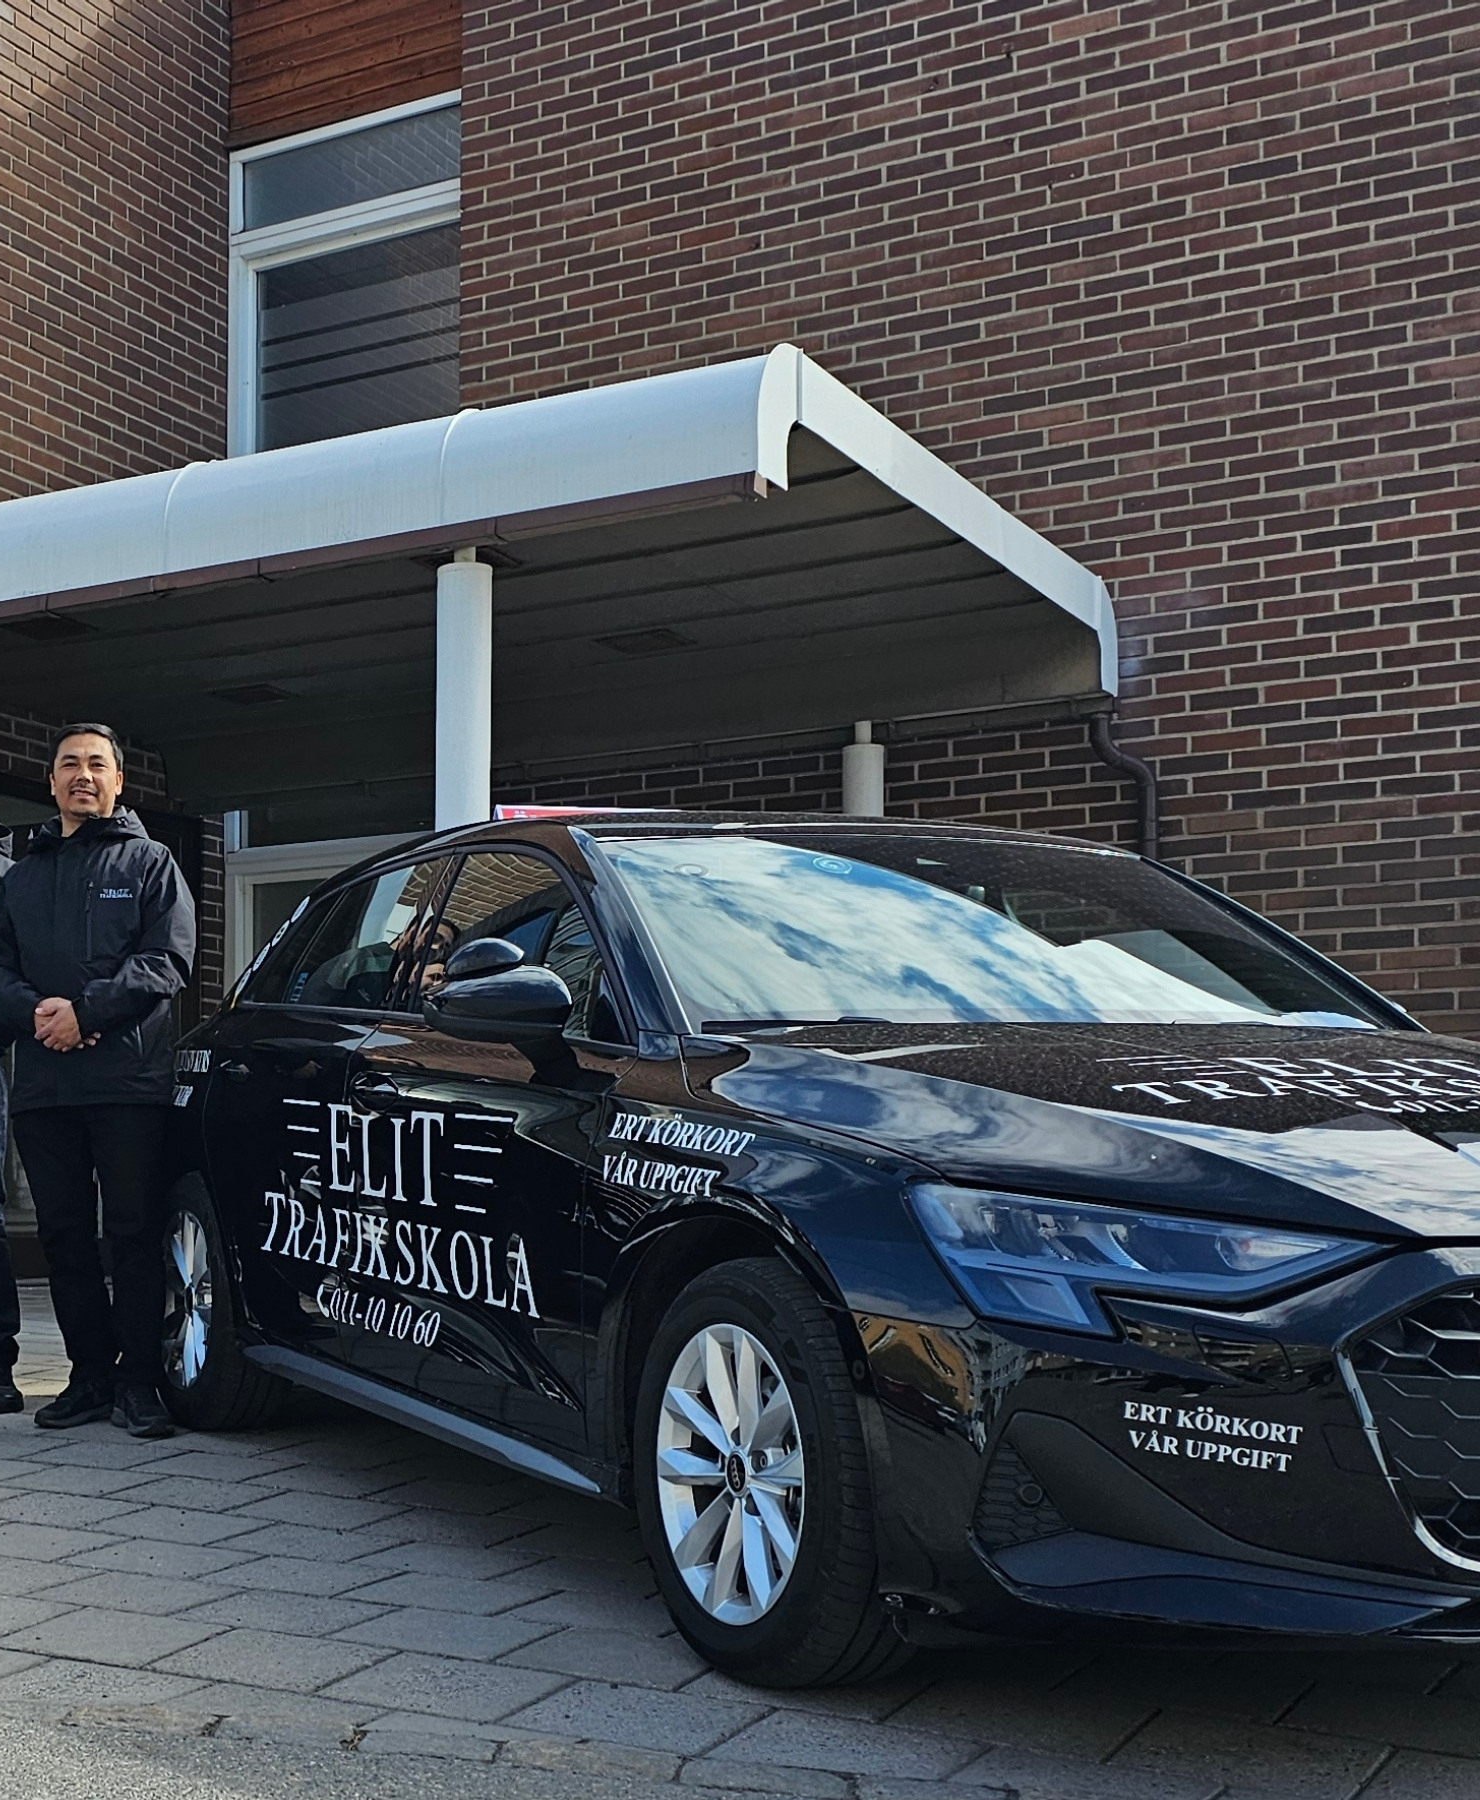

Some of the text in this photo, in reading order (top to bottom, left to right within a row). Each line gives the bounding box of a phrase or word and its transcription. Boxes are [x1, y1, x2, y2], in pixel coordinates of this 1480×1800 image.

[327, 1103, 444, 1207] ELIT
[608, 1112, 756, 1157] ERT KÖRKORT
[602, 1151, 721, 1197] VÅR UPPGIFT
[260, 1191, 540, 1319] TRAFIKSKOLA
[329, 1287, 441, 1348] 011-10 10 60
[1123, 1400, 1303, 1445] ERT KÖRKORT
[1128, 1430, 1292, 1472] VÅR UPPGIFT
